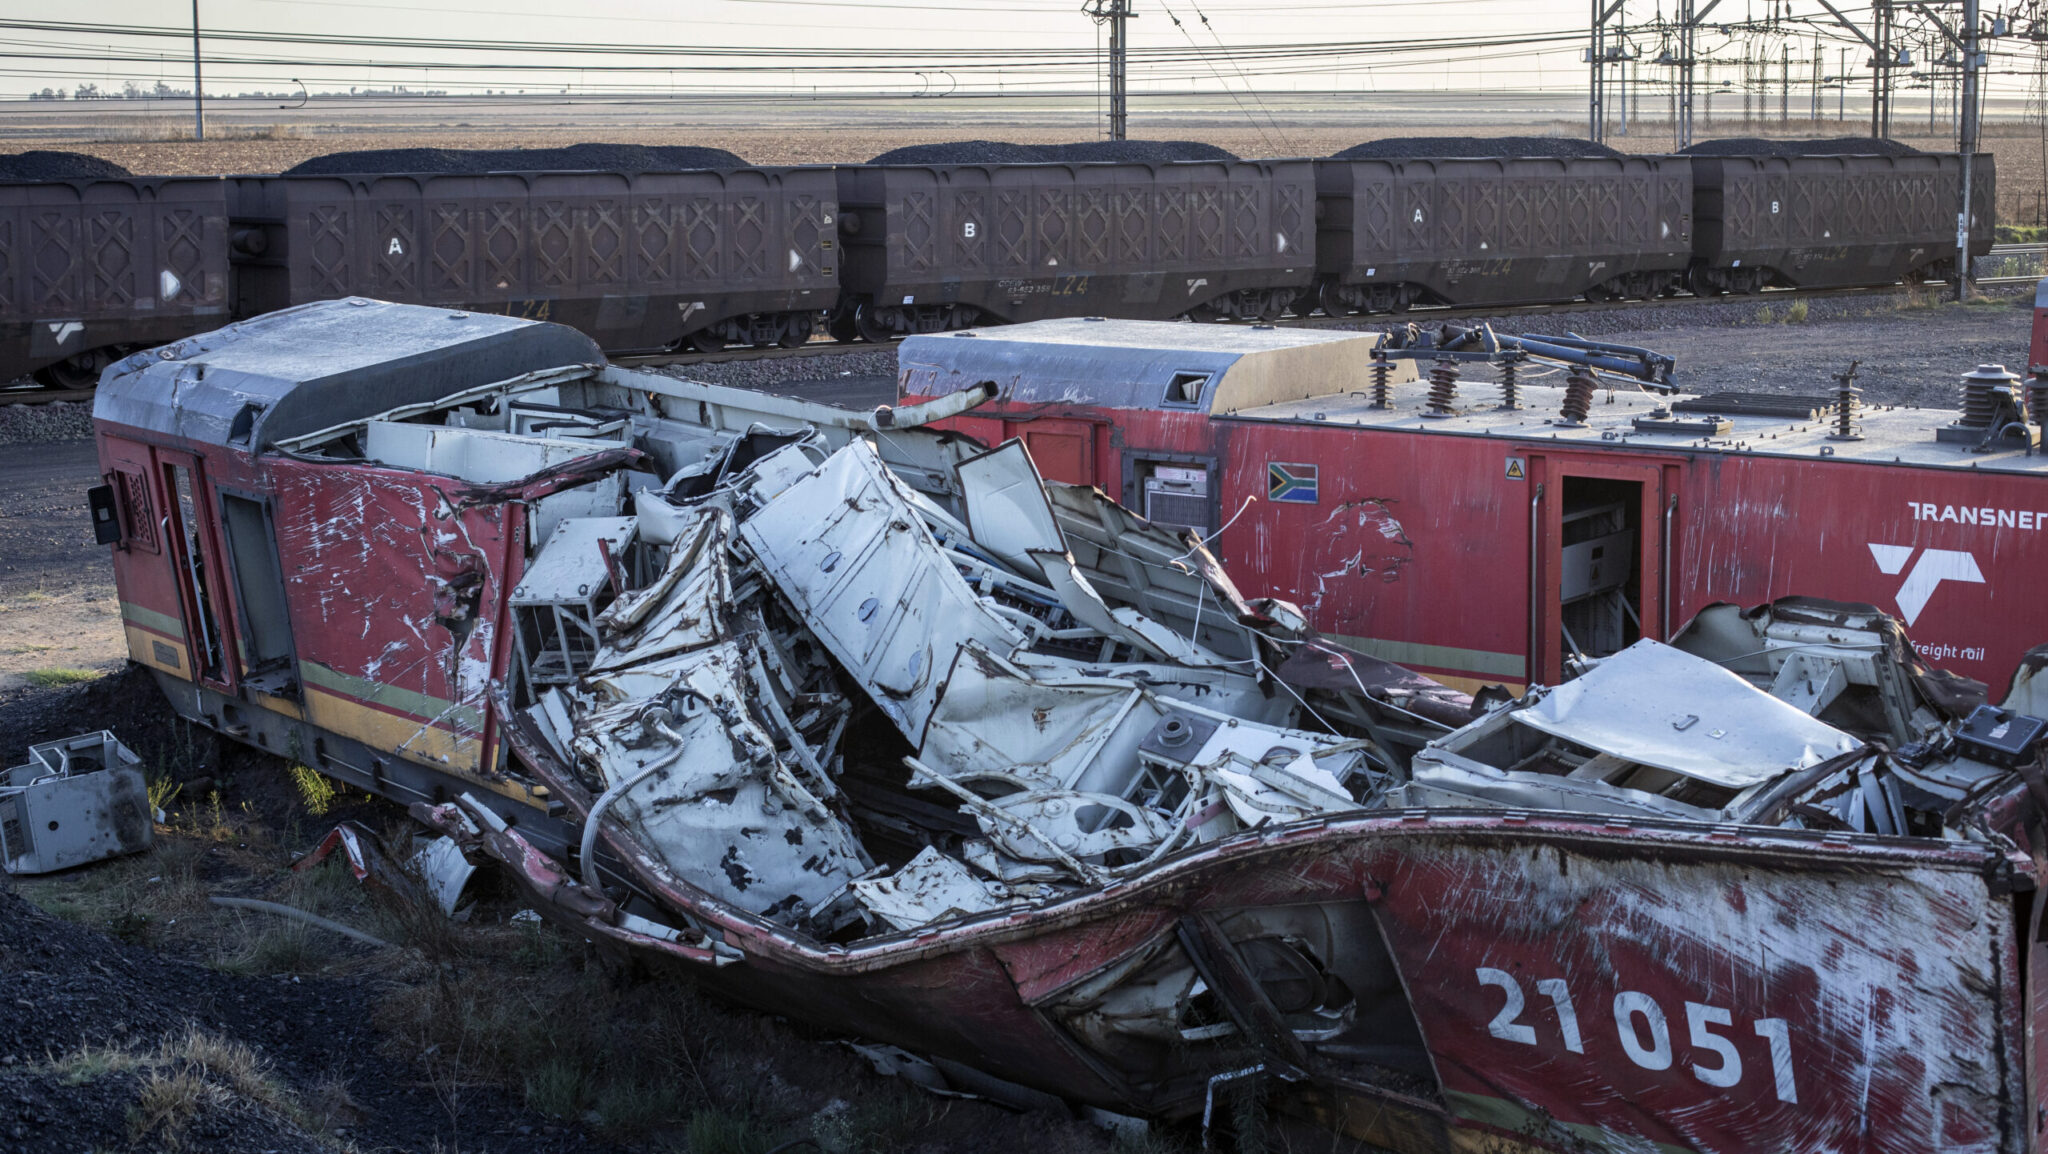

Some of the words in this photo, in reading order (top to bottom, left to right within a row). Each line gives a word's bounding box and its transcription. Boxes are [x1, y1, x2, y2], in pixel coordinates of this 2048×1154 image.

[1413, 208, 1423, 224] A
[964, 222, 976, 239] B
[387, 237, 403, 256] A
[1907, 501, 2048, 531] TRANSNET
[1960, 647, 1985, 662] rail
[1475, 967, 1585, 1055] 21
[1612, 990, 1798, 1104] 051
